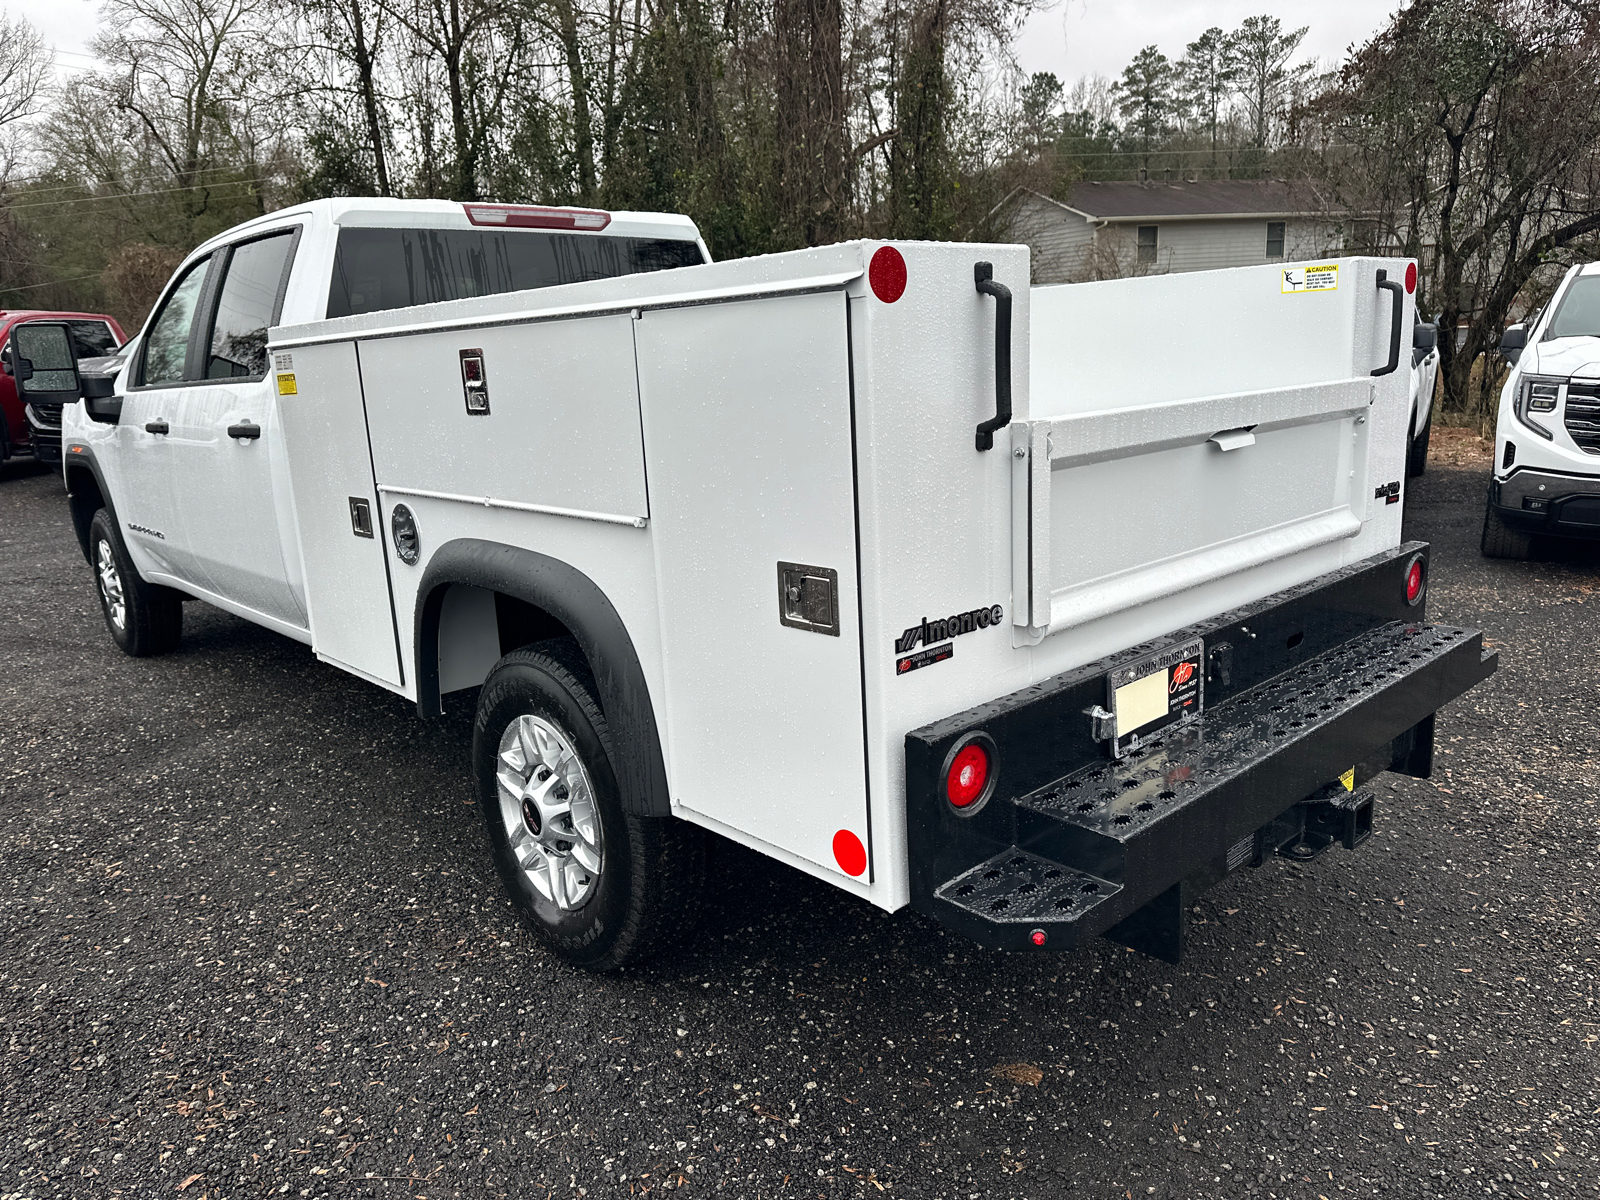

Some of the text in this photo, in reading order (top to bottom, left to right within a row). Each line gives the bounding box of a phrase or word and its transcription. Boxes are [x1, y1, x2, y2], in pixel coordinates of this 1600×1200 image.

[926, 604, 1004, 643] monroe
[912, 645, 952, 662] JOHN THORNTON
[1135, 660, 1157, 677] JOHN
